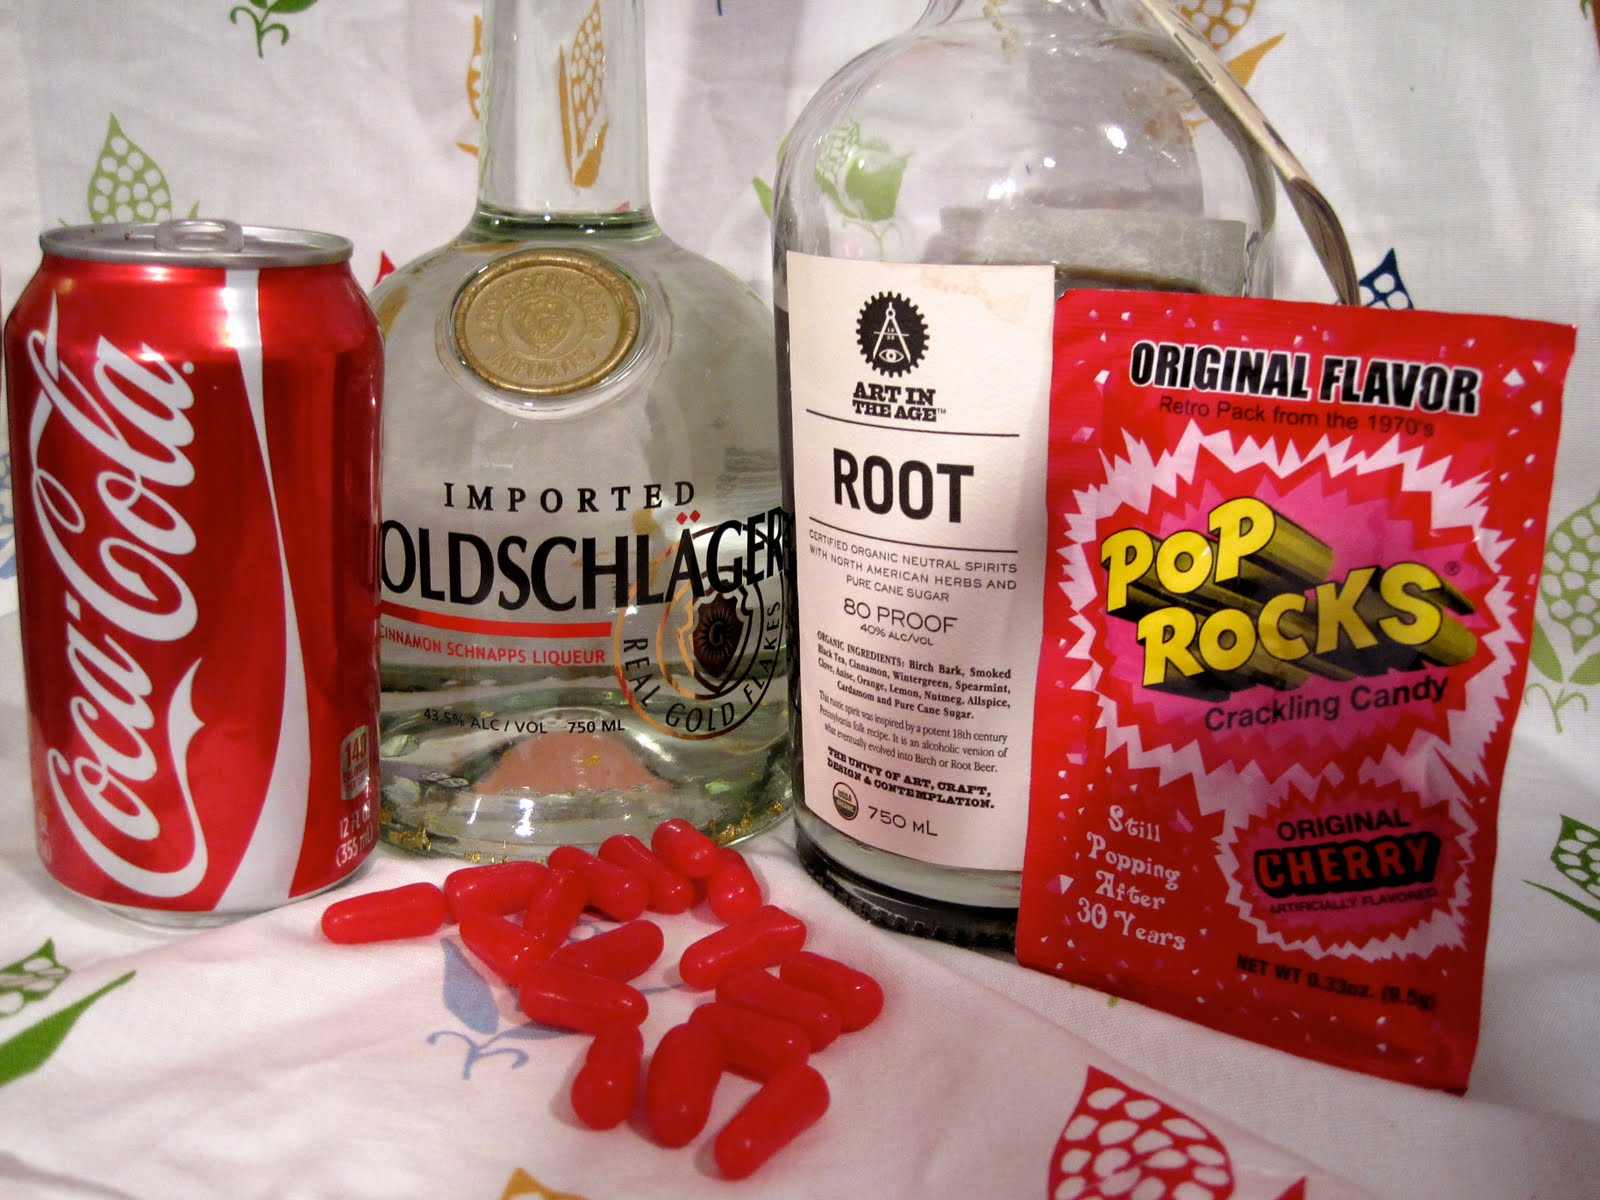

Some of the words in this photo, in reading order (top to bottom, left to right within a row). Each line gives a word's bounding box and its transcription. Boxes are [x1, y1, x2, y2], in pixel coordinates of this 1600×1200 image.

[853, 381, 901, 402] ART
[905, 387, 936, 406] IN
[1131, 340, 1311, 401] ORIGINAL
[1320, 354, 1482, 415] FLAVOR
[852, 400, 892, 419] THE
[894, 405, 937, 422] AGE
[1159, 396, 1210, 418] Retro
[1217, 401, 1265, 423] Pack
[1273, 407, 1318, 427] from
[1326, 412, 1359, 429] the
[1368, 415, 1435, 438] 1970's
[444, 480, 696, 513] IMPORTED
[833, 447, 974, 523] ROOT
[380, 506, 784, 612] OLDSCHLÄGER
[809, 529, 849, 552] CERTIFIED
[851, 545, 898, 563] ORGANIC
[902, 555, 960, 571] NEUTRAL
[965, 561, 1018, 573] SPIRITS
[809, 544, 828, 560] WITH
[830, 554, 863, 572] NORTH
[866, 564, 929, 584] AMERICAN
[934, 575, 982, 589] HERBS
[986, 579, 1017, 590] AND
[1100, 496, 1276, 612] POP
[846, 574, 872, 591] PURE
[874, 581, 904, 597] CANE
[906, 588, 950, 602] SUGAR
[843, 597, 871, 620] 80
[877, 606, 958, 634] PROOF
[860, 623, 886, 638] 40%
[888, 629, 934, 646] ALC/VOL
[1137, 561, 1444, 689] ROCKS
[447, 642, 526, 664] SCHNAPPS
[533, 649, 606, 666] LIQUEUR
[623, 638, 661, 707] REAL
[665, 701, 735, 733] GOLD
[742, 601, 781, 705] FLAKES
[817, 630, 845, 651] ORGANIC
[847, 643, 905, 667] INGREDIENTS:
[909, 659, 934, 673] Birch
[938, 664, 965, 677] Bark,
[970, 667, 1011, 679] Smoked
[817, 643, 833, 660] Black
[834, 651, 847, 667] Tea,
[849, 658, 890, 679] Cinnamon,
[892, 670, 952, 690] Wintergreen,
[955, 680, 1011, 695] Spearmint,
[818, 656, 835, 675] Clove,
[836, 665, 856, 683] Anise,
[857, 674, 887, 693] Orange,
[889, 684, 922, 699] Lemon,
[924, 690, 965, 706] Nutmeg,
[967, 695, 1011, 710] Allspice,
[837, 680, 875, 702] Cardamom
[877, 694, 892, 706] and
[894, 699, 915, 712] Pure
[917, 703, 940, 716] Cane
[943, 706, 975, 721] Sugar.
[1204, 692, 1341, 732] Crackling
[1350, 673, 1449, 712] Candy
[424, 708, 465, 727] 43.5%
[470, 718, 500, 732] ALC
[516, 721, 548, 734] VOL
[567, 721, 597, 734] 750
[601, 719, 625, 732] ML
[845, 704, 860, 716] spirit
[861, 711, 874, 721] was
[874, 713, 904, 729] inspired
[905, 720, 915, 734] by
[916, 725, 922, 733] a
[922, 725, 950, 738] potent
[952, 729, 972, 740] 18th
[973, 733, 1008, 744] century
[853, 720, 865, 733] folk
[867, 728, 891, 742] recipe.
[893, 733, 899, 743] It
[901, 736, 908, 745] is
[909, 739, 920, 748] an
[922, 740, 960, 755] alcoholic
[962, 746, 995, 757] version
[997, 747, 1009, 758] of
[828, 746, 847, 763] THE
[848, 756, 883, 777] UNITY
[885, 769, 901, 781] OF
[903, 775, 935, 790] ART,
[937, 781, 991, 797] CRAFT,
[837, 730, 868, 750] eventually
[868, 743, 896, 758] evolved
[897, 750, 914, 762] into
[915, 754, 937, 767] Birch
[939, 759, 949, 768] or
[951, 759, 972, 771] Root
[974, 762, 998, 773] Beer.
[827, 758, 862, 782] DESIGN
[863, 776, 872, 786] &
[874, 779, 995, 809] CONTEMPLATION.
[868, 806, 907, 830] 750
[1108, 804, 1161, 844] Still
[1277, 808, 1412, 842] ORIGINAL
[1086, 830, 1181, 891] Popping
[1256, 834, 1434, 893] CHERRY
[1094, 869, 1166, 911] After
[1268, 898, 1359, 915] ARTIFICIALLY
[1076, 896, 1109, 930] 30
[1113, 910, 1186, 951] Years
[1236, 954, 1268, 977] NET
[1274, 964, 1303, 984] WT
